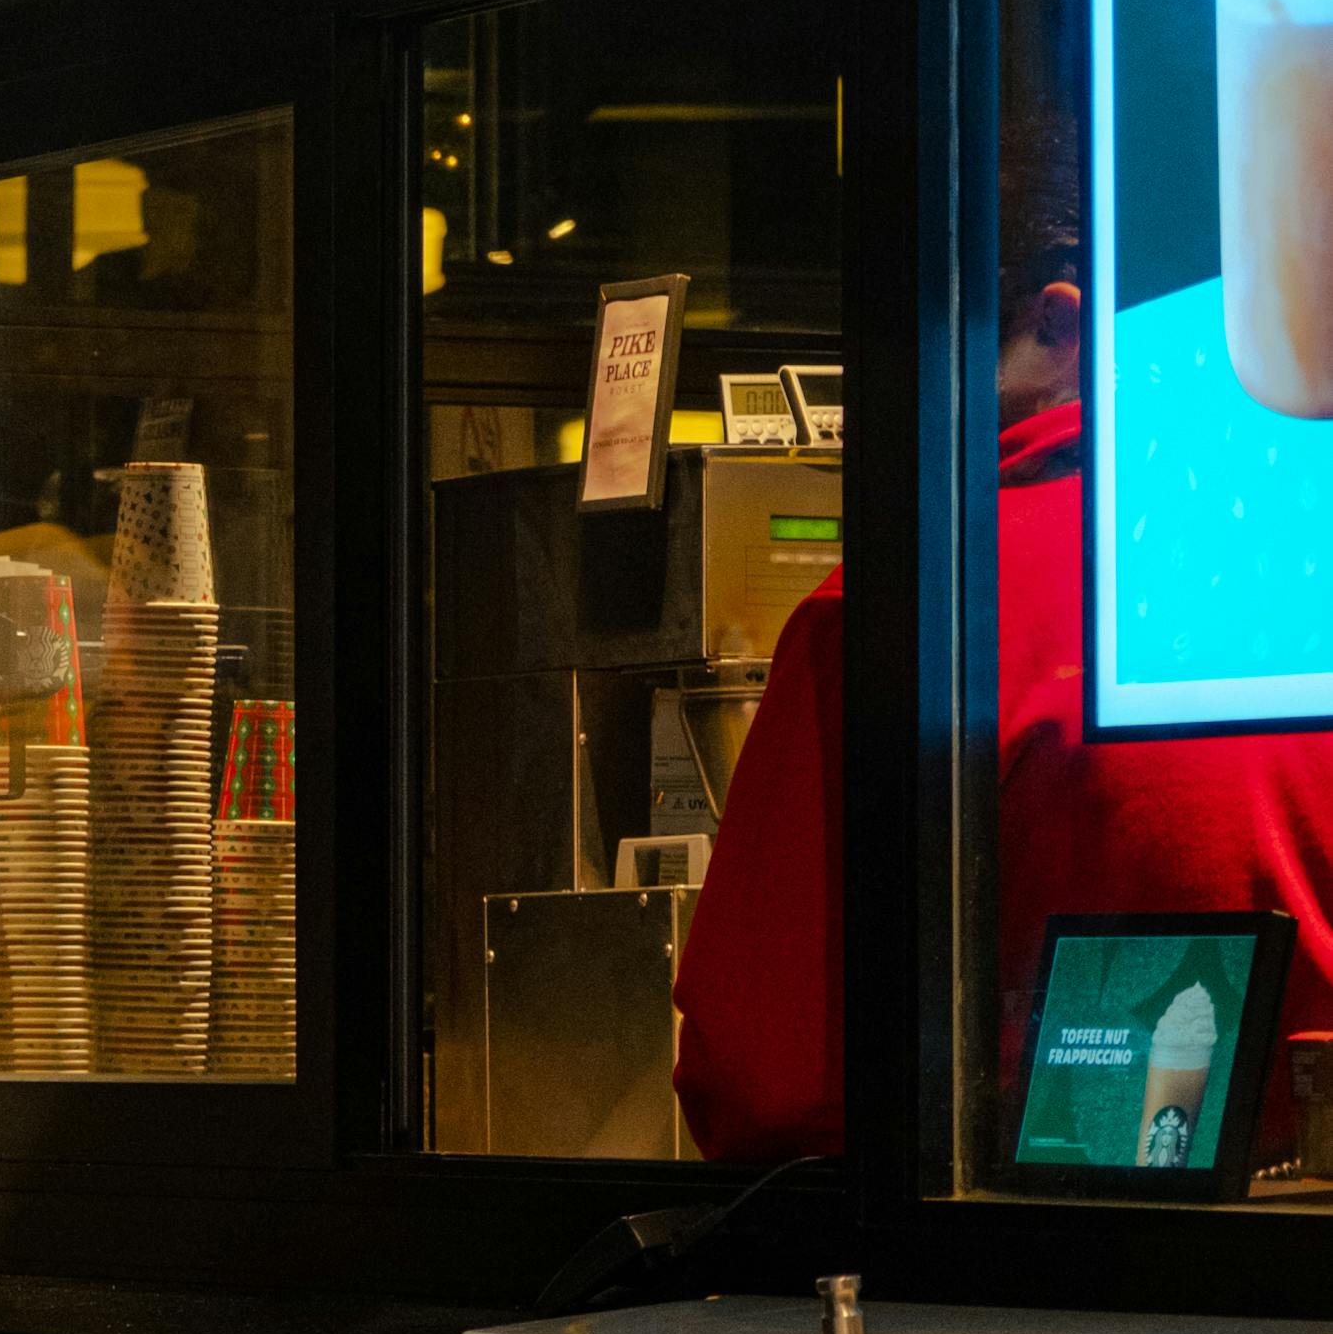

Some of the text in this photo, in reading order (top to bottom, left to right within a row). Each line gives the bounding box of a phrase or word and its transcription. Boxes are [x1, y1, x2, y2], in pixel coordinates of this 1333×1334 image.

[608, 330, 656, 359] PIKE
[605, 360, 652, 383] PLACE
[1060, 1028, 1130, 1045] TOFFEE NUT
[1047, 1048, 1133, 1066] FRAPPUCCINO
